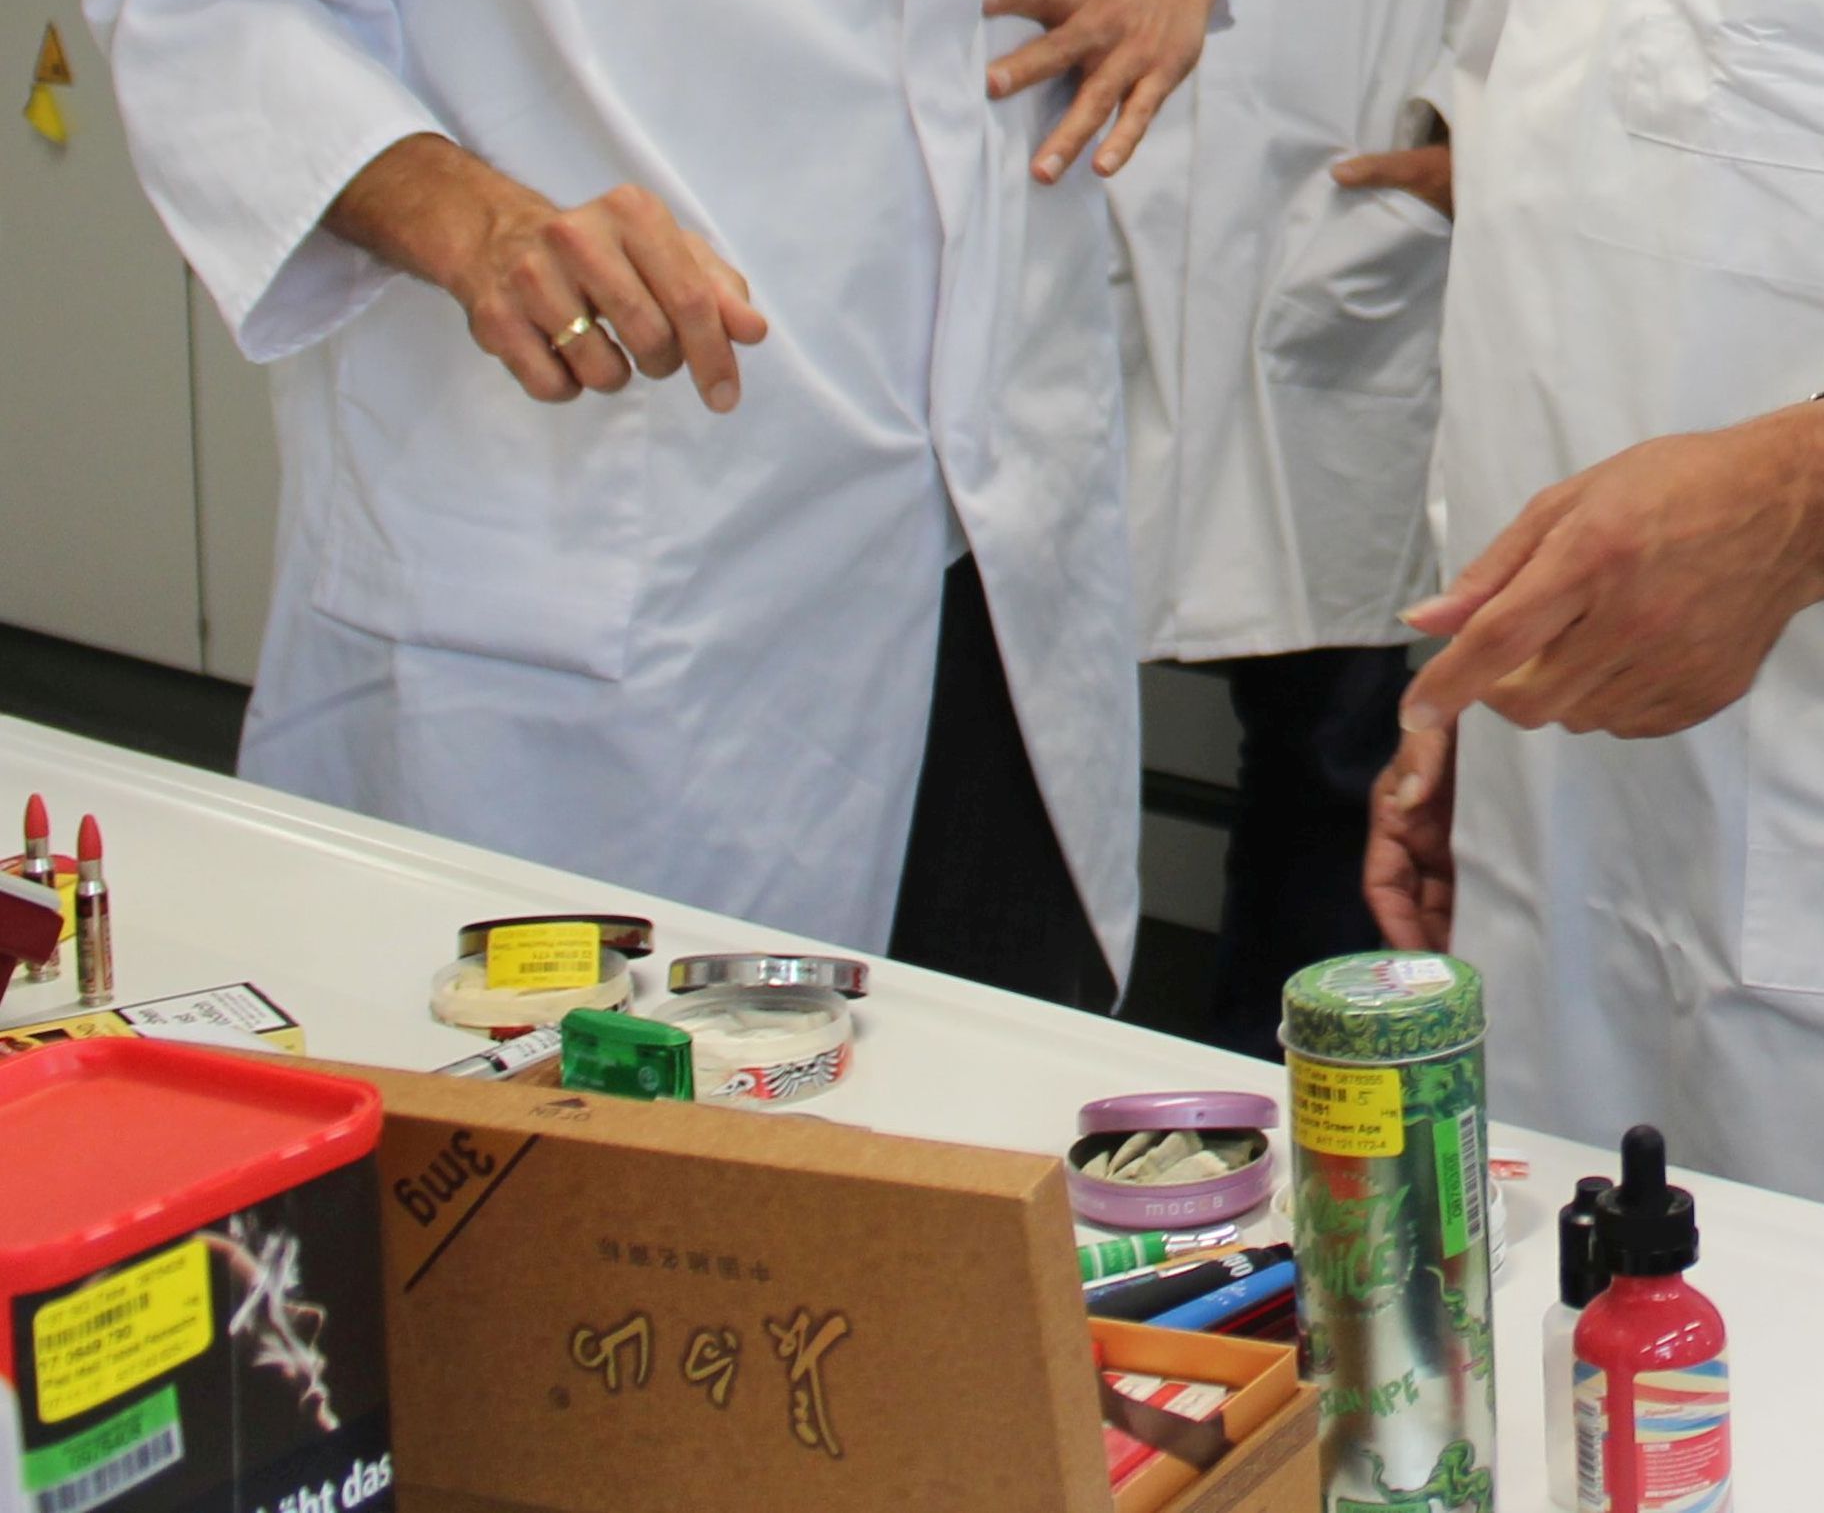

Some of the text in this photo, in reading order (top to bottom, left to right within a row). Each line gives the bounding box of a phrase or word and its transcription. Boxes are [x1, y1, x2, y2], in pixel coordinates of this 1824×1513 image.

[393, 1130, 496, 1228] 3mg
[1144, 1195, 1225, 1217] mocca
[341, 1452, 394, 1509] das
